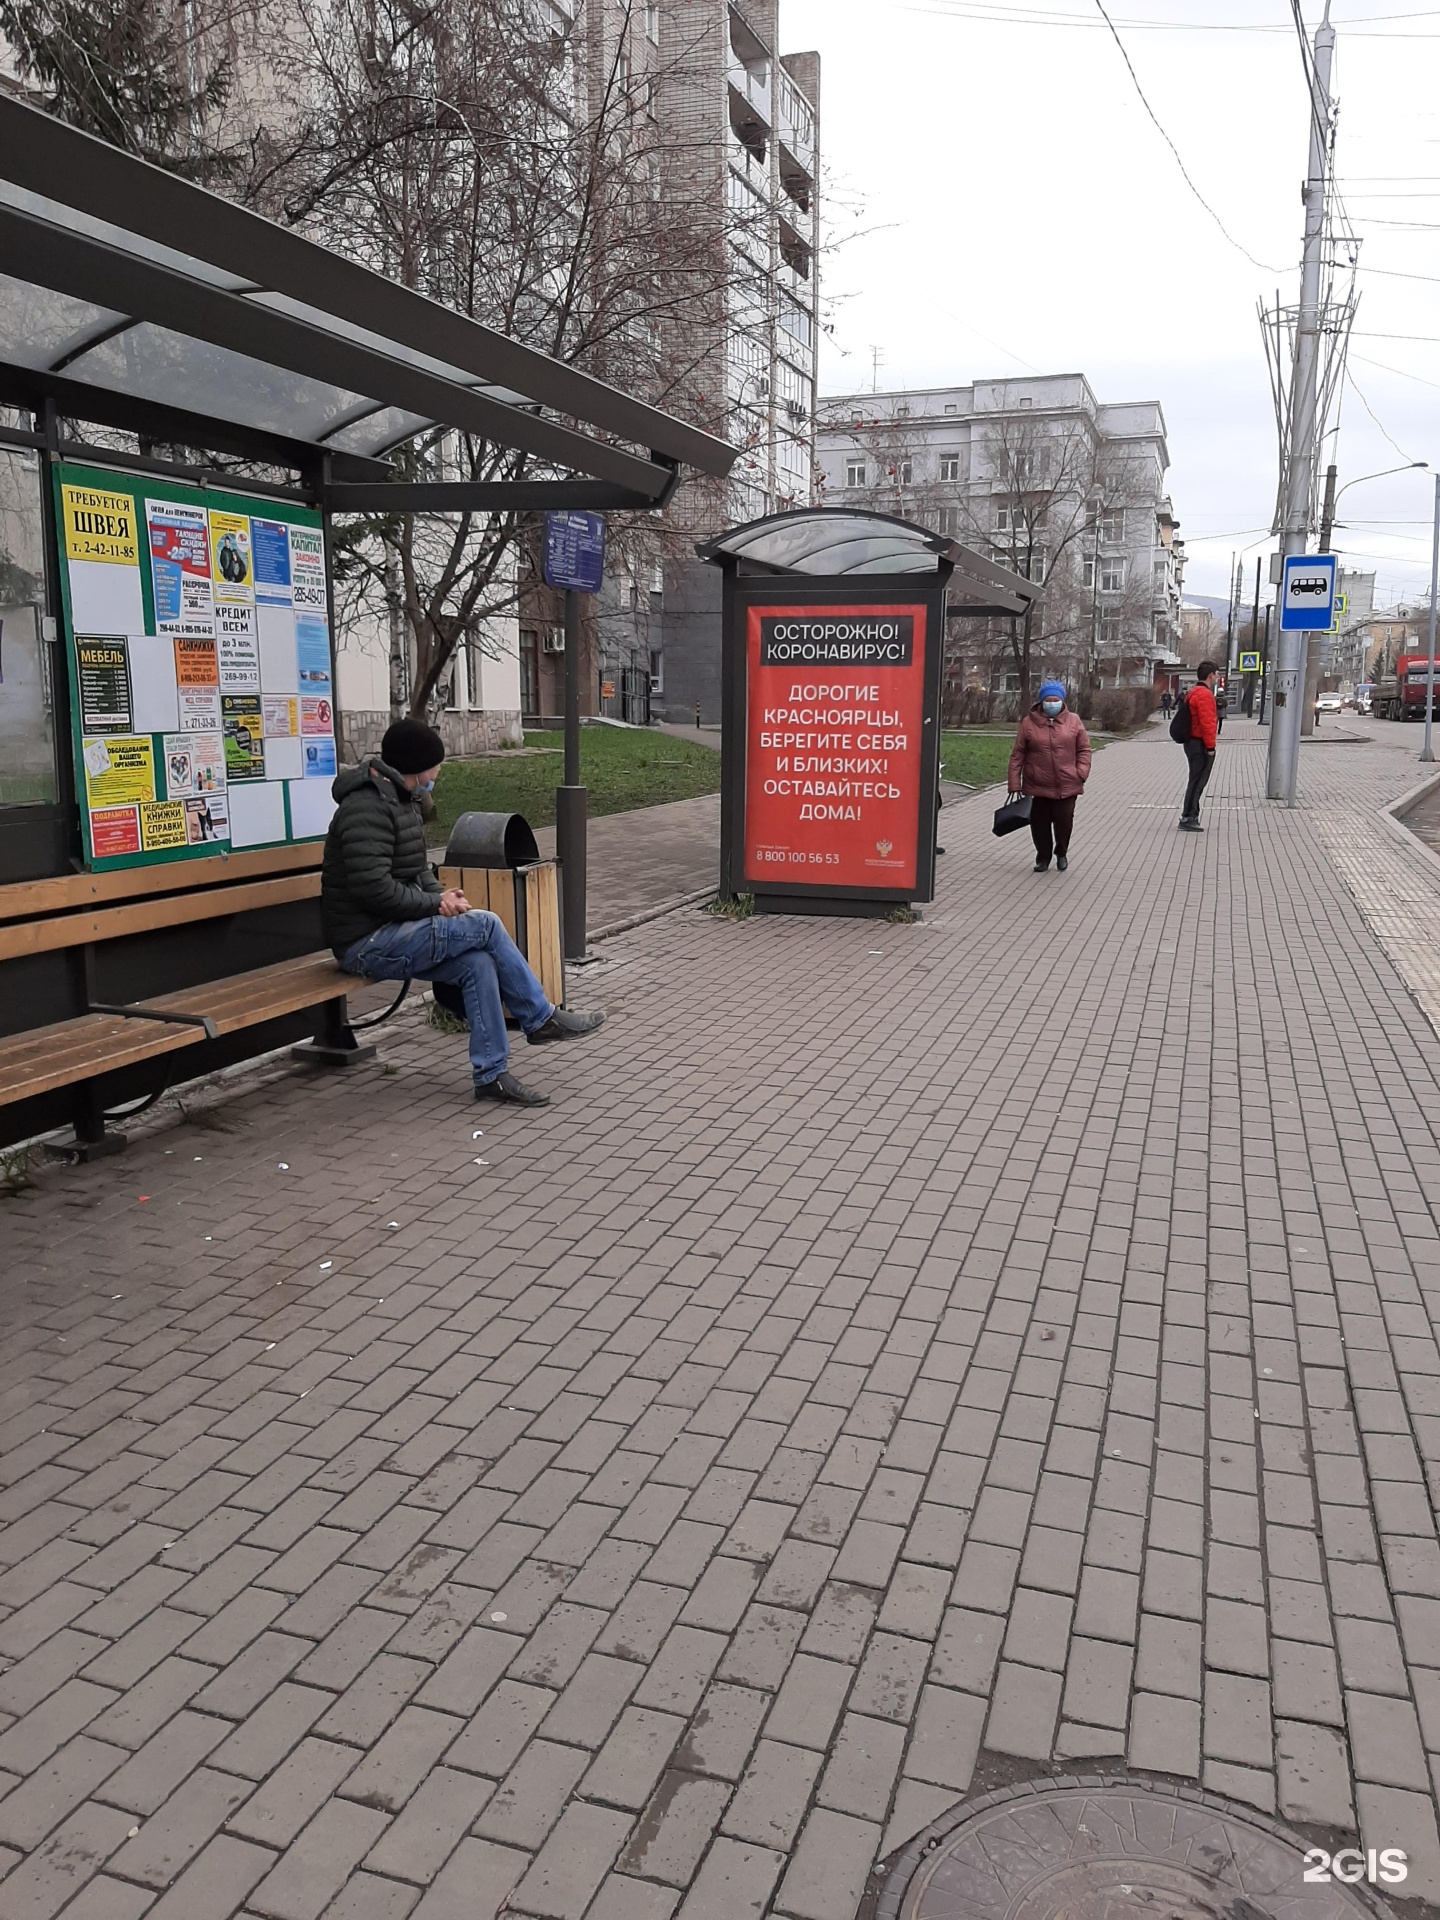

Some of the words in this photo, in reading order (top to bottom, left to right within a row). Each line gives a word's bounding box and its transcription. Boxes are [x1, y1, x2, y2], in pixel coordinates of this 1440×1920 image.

[68, 490, 130, 512] ТРЕБУЕТСЯ
[73, 510, 130, 538] ШВЕЯ
[72, 542, 82, 553] т.
[84, 541, 135, 559] 2-42-11-85
[291, 538, 323, 555] КАПИТАЛ
[295, 551, 320, 564] ЗАКОННО
[293, 586, 326, 606] 285-49-07
[215, 606, 253, 620] КРЕДИТ
[222, 620, 249, 633] ВСЕМ
[773, 624, 899, 640] ОСТОРОЖНО!
[178, 639, 215, 653] САНКНИЖКИ
[231, 638, 237, 648] 3
[80, 649, 125, 664] МЕБЕЛЬ
[767, 643, 905, 660] КОРОНАВИРУС!
[788, 684, 880, 702] ДОРОГИЕ
[764, 708, 903, 727] КРАСНОЯРЦЫ,
[760, 732, 852, 749] БЕРЕГИТЕ
[857, 734, 908, 750] СЕБЯ
[107, 745, 150, 754] ОБСЛЕДОВАНИЕ
[118, 753, 142, 761] ВАШЕГО
[113, 760, 148, 769] ОРГАНИЗМА
[776, 756, 789, 772] И
[793, 757, 888, 774] БЛИЗКИХ!
[763, 778, 901, 799] ОСТАВАЙТЕСЬ
[142, 801, 183, 812] МЕДИЦИНСКИЕ
[799, 804, 861, 821] ДОМА!
[94, 809, 135, 820] ПОДРАБОТКА
[146, 808, 181, 822] КНИЖКИ
[147, 821, 183, 834] СПРАВКИ
[756, 850, 763, 861] 8
[765, 851, 785, 862] 800
[788, 852, 806, 863] 100
[808, 853, 823, 864] 56
[825, 853, 840, 864] 53
